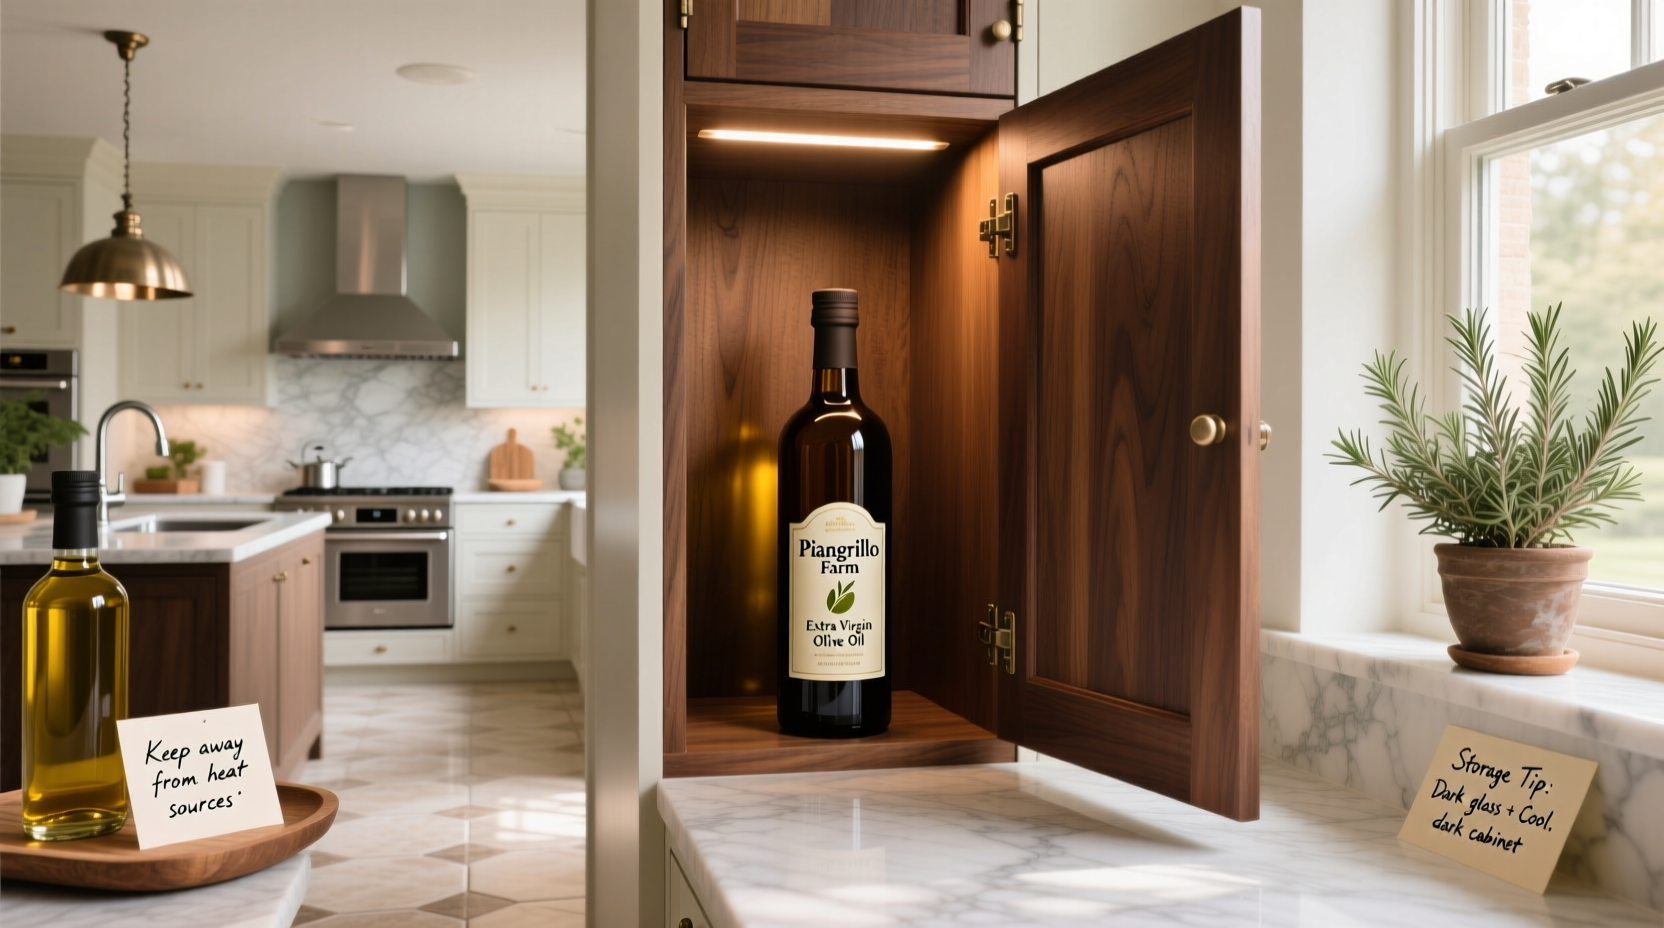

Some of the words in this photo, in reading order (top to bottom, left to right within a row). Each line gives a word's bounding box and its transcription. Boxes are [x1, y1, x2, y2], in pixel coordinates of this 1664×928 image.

[798, 538, 880, 563] Piangrillo
[820, 560, 860, 575] Farm
[806, 619, 837, 632] Extra
[839, 618, 873, 635] Virgin
[812, 634, 845, 648] Olive
[847, 632, 866, 647] Oil
[144, 739, 192, 770] Keep
[198, 737, 244, 761] away
[151, 769, 199, 799] from
[206, 758, 250, 783] heat
[1451, 747, 1512, 790] Storage
[1519, 766, 1554, 800] Tip:
[1430, 778, 1466, 805] Dark
[1463, 793, 1503, 817] glass
[1506, 804, 1516, 817] +
[1431, 811, 1465, 838] dark
[1468, 825, 1524, 855] cabinet
